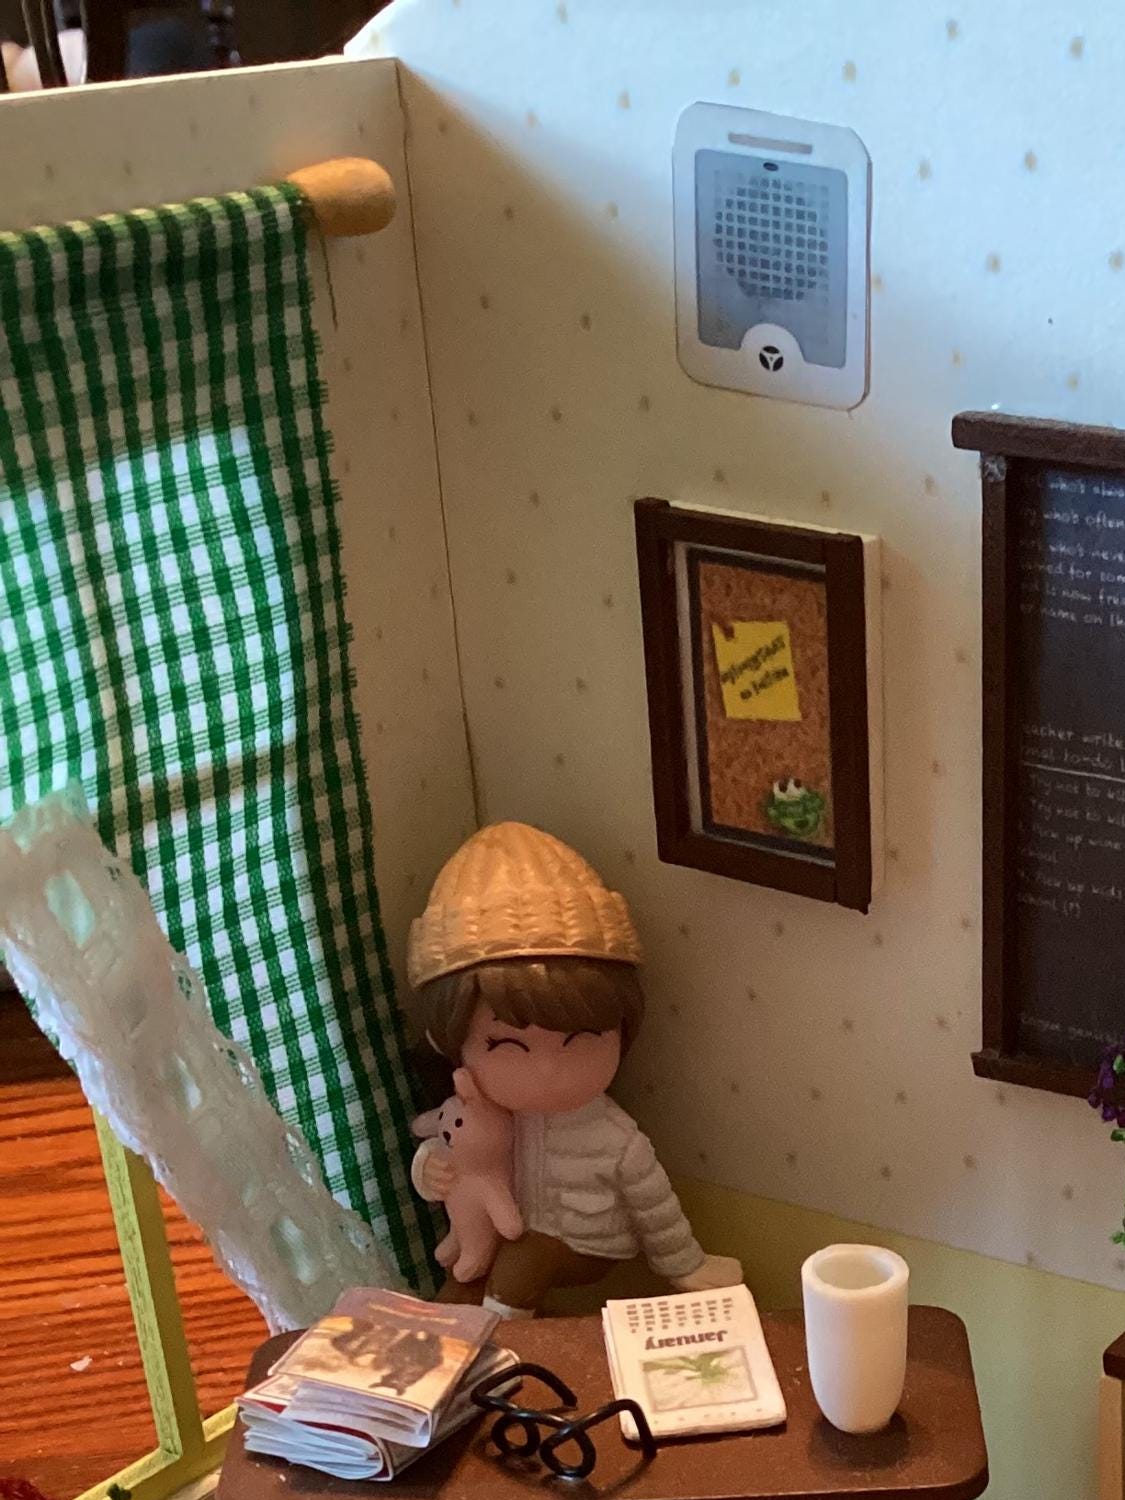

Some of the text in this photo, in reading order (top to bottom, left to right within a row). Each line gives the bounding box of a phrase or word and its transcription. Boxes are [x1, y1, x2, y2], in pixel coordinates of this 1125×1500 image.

[1085, 510, 1125, 531] often
[1023, 722, 1074, 741] eacher
[644, 1329, 729, 1351] January
